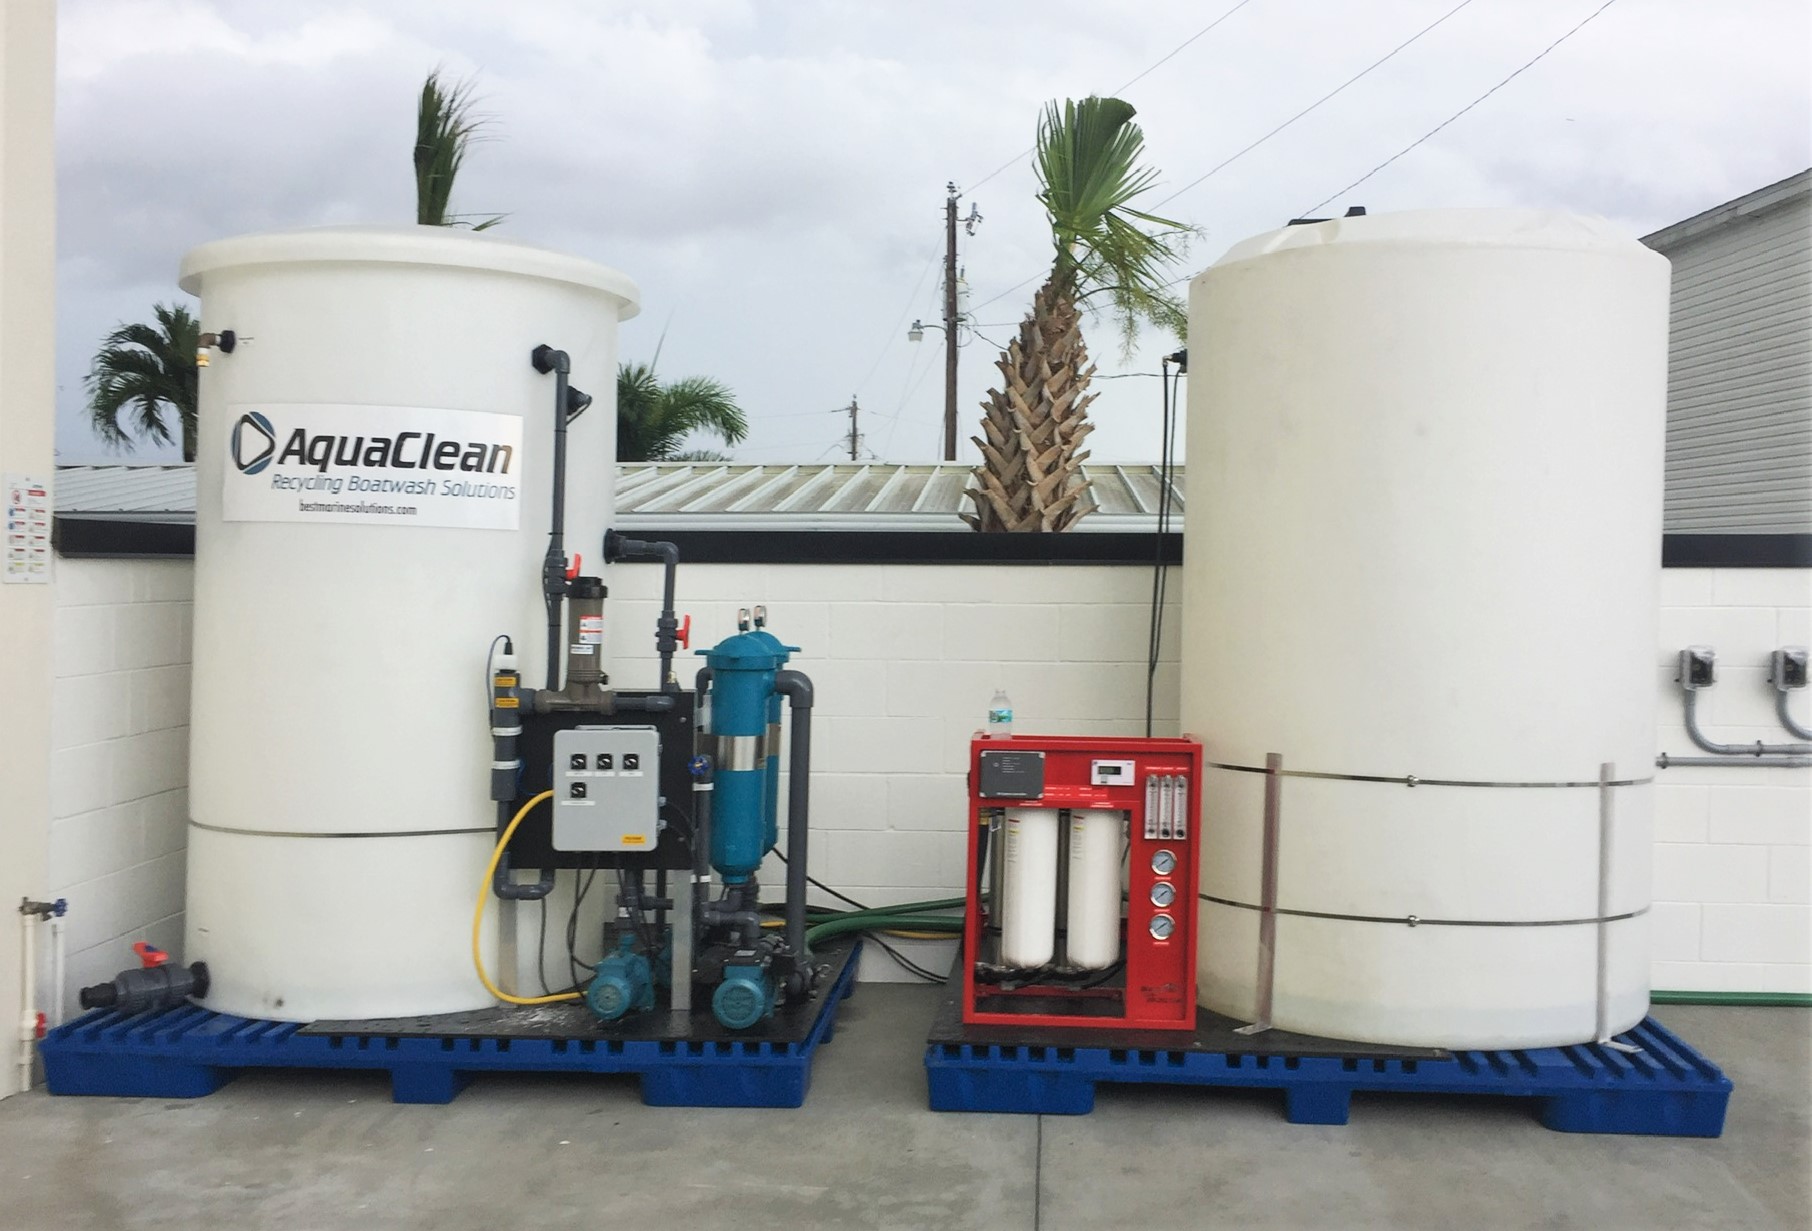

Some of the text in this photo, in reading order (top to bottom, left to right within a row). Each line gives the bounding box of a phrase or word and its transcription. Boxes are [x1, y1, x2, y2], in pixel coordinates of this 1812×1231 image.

[277, 428, 513, 475] AquaClean
[271, 473, 516, 499] Recycling Boatwash Solutions
[298, 499, 417, 515] bestmarinesolutions.com
